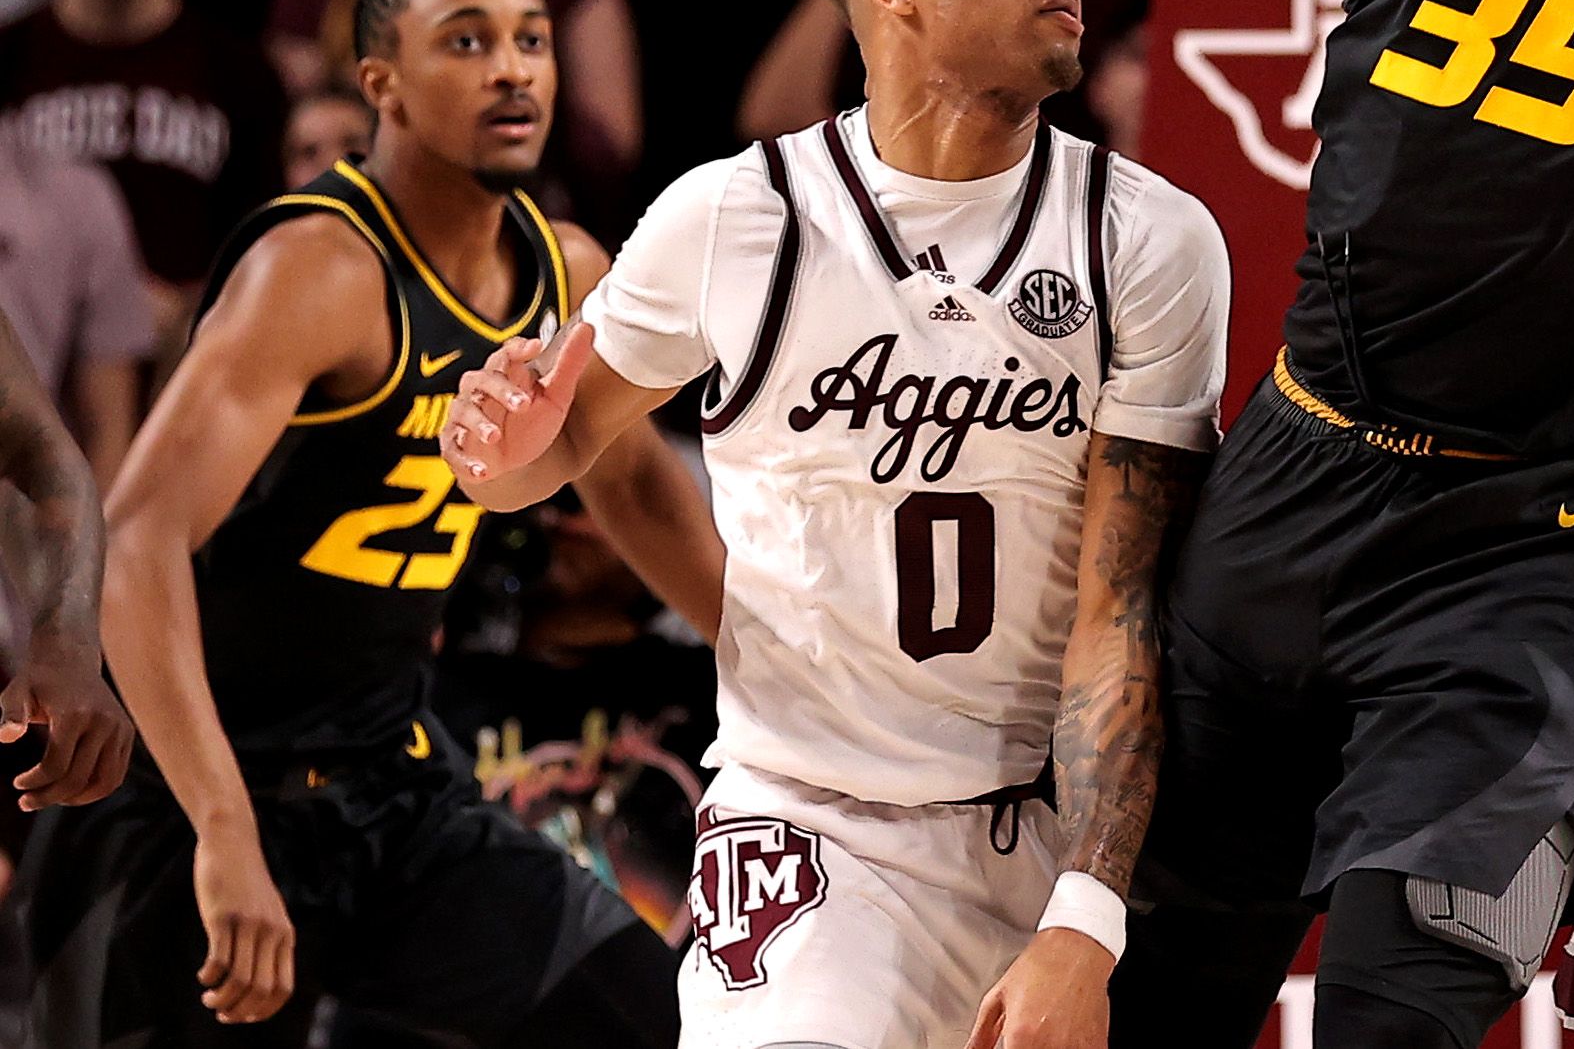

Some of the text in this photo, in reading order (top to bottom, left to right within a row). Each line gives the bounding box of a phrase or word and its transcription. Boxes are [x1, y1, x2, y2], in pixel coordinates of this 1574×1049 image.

[928, 309, 977, 322] adidas
[1022, 271, 1075, 321] SEC
[1017, 311, 1083, 338] GRADUATE
[787, 333, 1088, 485] Aggies
[893, 490, 996, 664] 0
